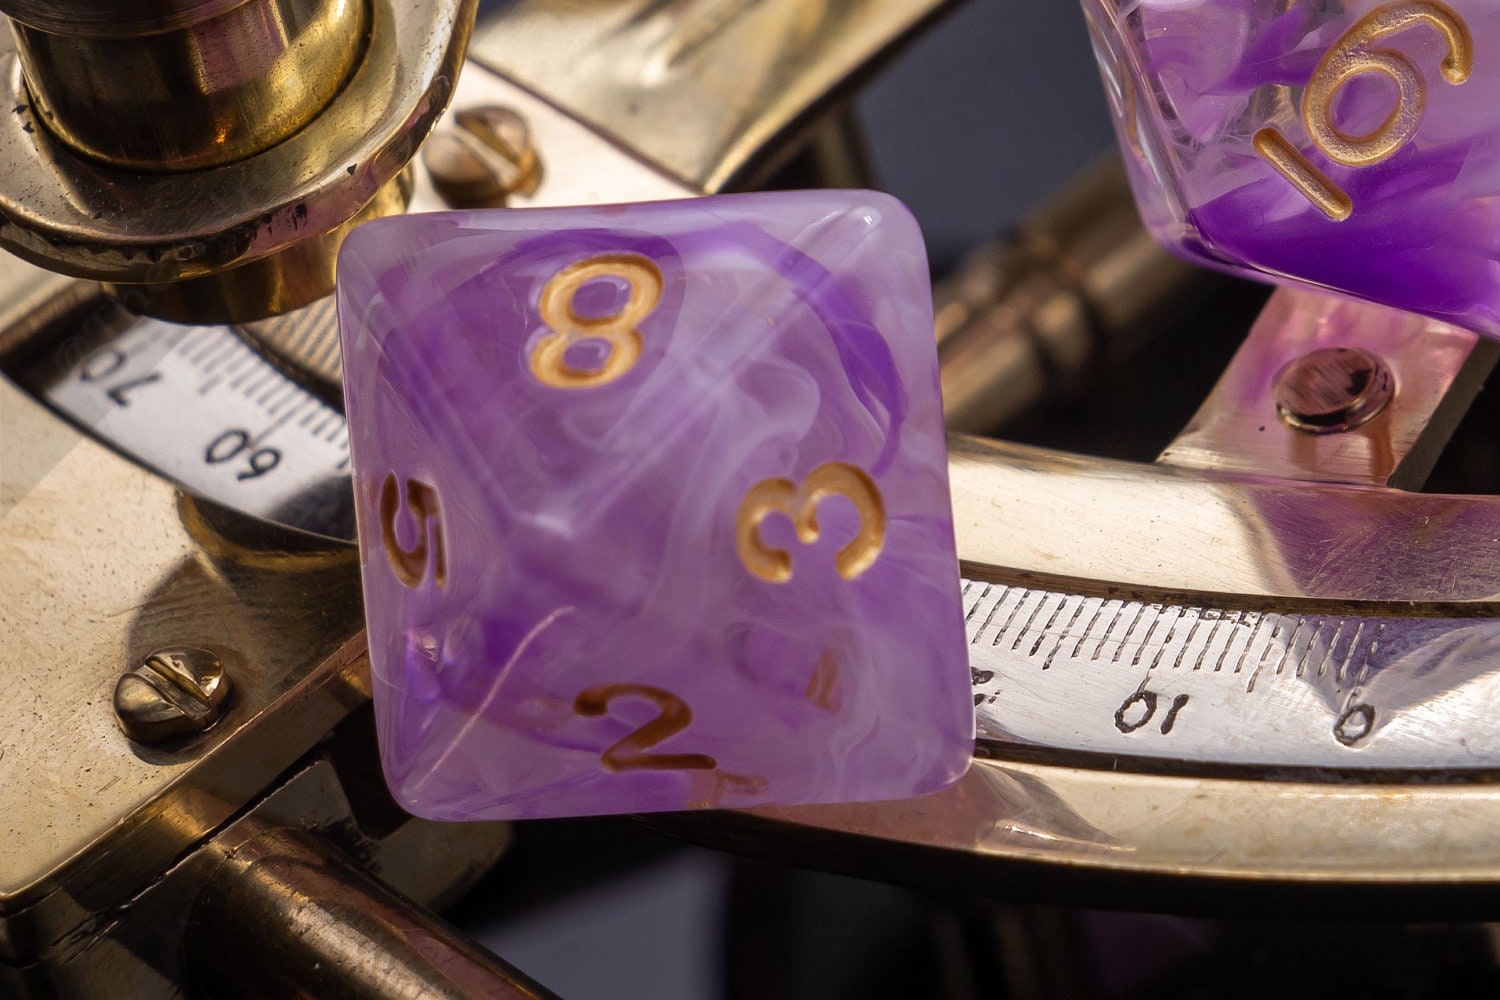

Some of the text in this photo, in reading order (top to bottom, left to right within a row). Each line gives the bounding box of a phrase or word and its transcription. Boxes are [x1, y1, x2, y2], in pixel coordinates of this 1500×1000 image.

[528, 252, 664, 389] 8
[735, 461, 886, 585] 3
[573, 682, 717, 774] 2
